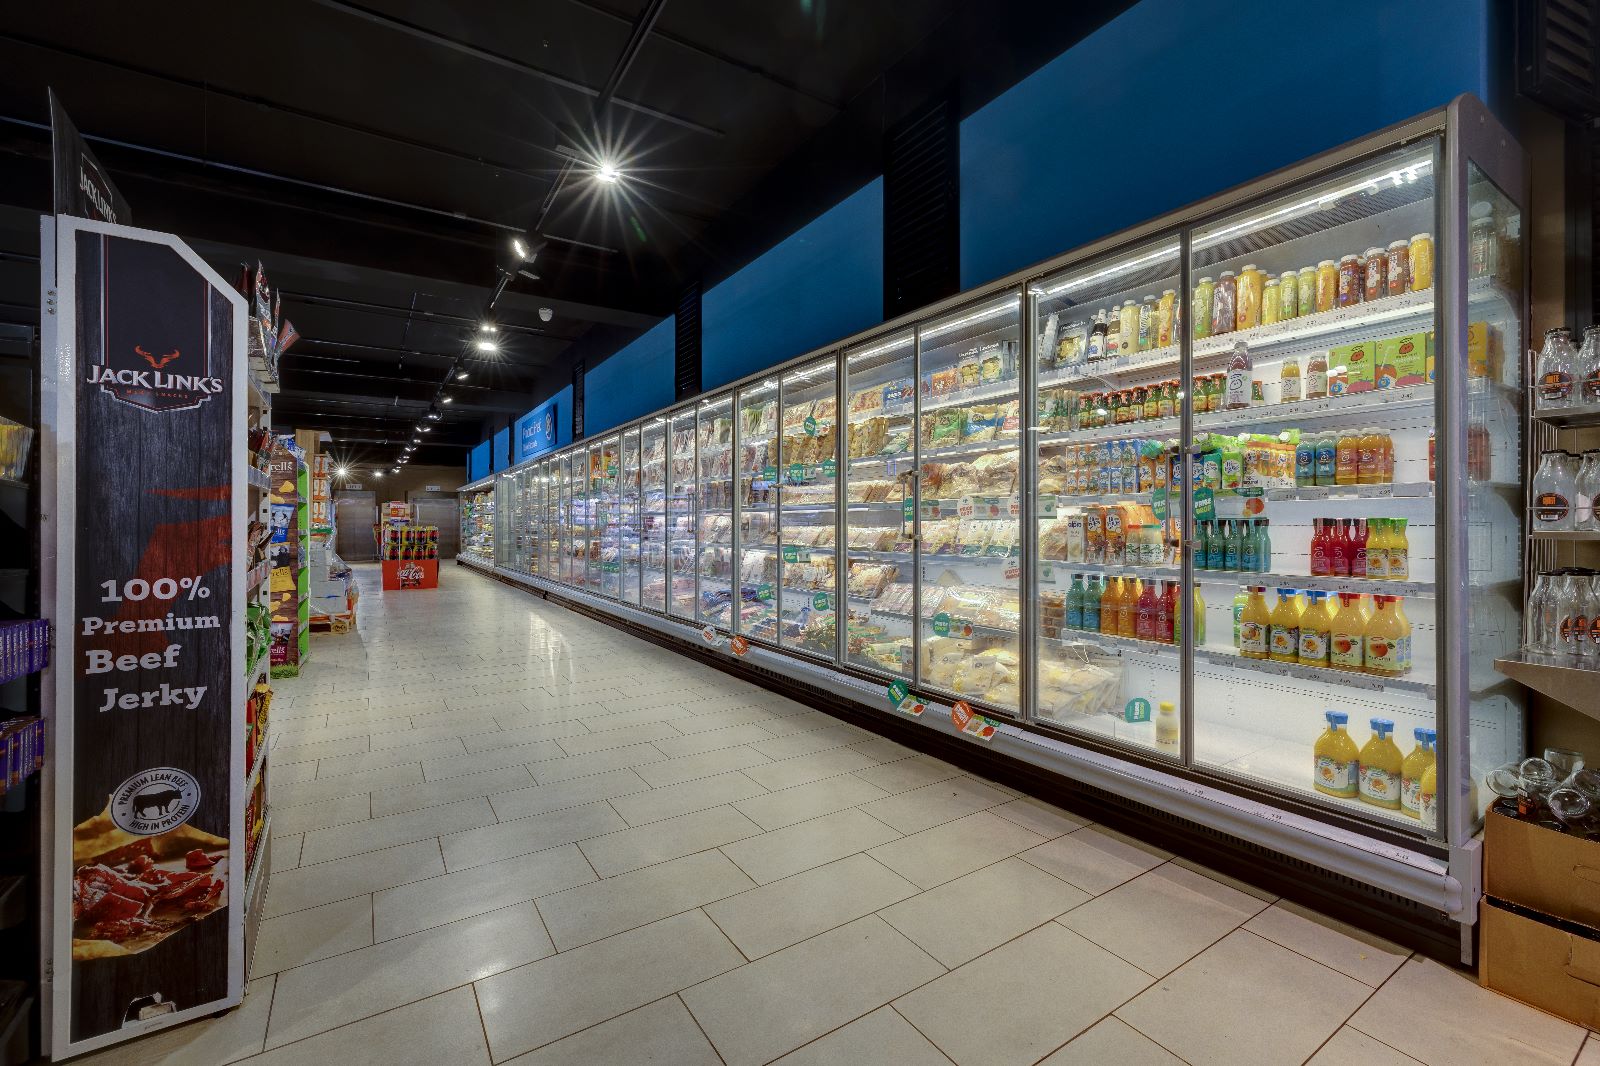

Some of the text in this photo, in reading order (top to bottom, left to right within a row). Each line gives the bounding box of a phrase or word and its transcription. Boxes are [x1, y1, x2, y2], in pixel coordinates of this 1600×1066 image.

[80, 165, 98, 209] JACK
[86, 365, 224, 394] JACK LINK'S
[101, 575, 211, 603] 100%
[82, 612, 220, 636] Premium
[85, 643, 183, 675] Beef
[99, 682, 208, 713] Jerky
[118, 773, 188, 805] PREMIUM LEAN BEEF
[129, 804, 191, 831] HIGH IN PROTEIN
